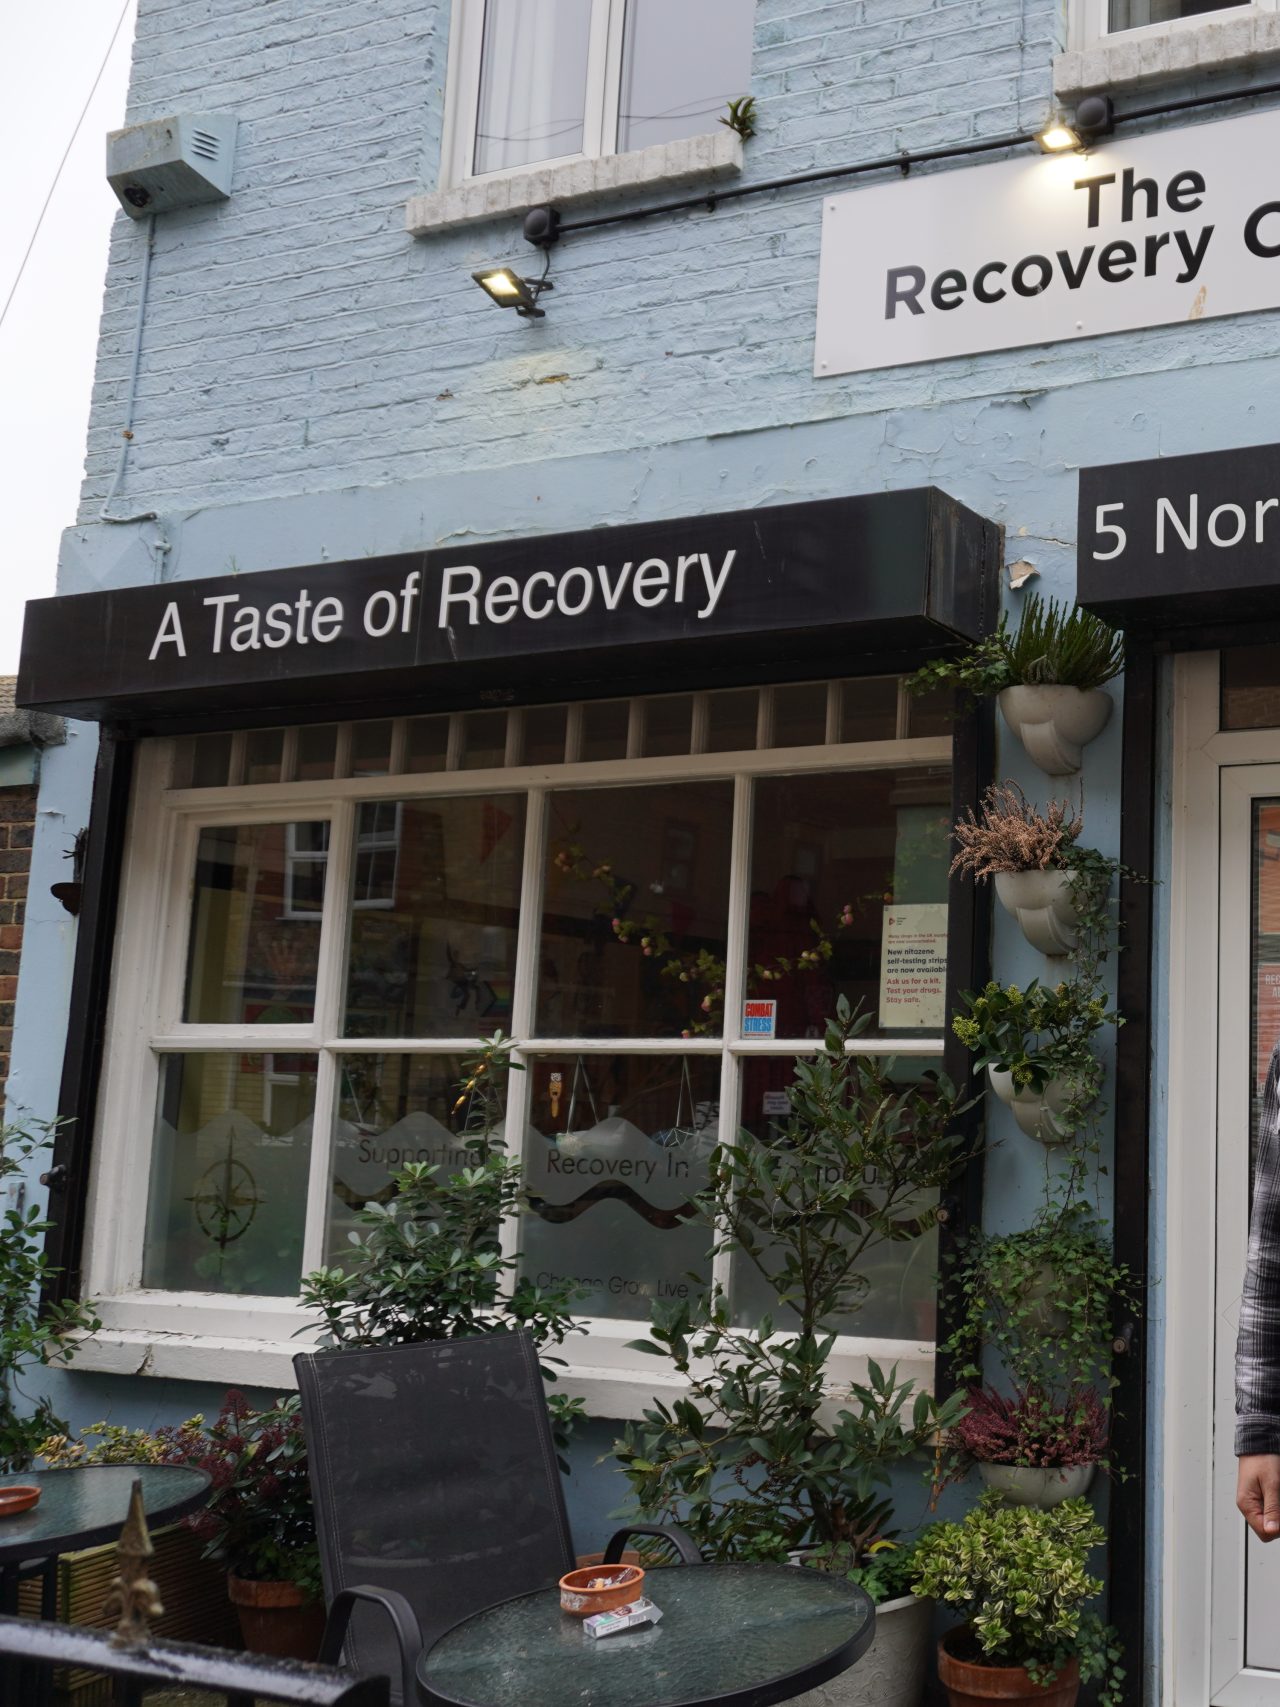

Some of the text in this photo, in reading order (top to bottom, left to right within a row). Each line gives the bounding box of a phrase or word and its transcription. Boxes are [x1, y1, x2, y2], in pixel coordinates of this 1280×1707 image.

[1075, 167, 1206, 229] The
[884, 224, 1216, 320] Recovery
[1092, 502, 1128, 561] 5
[148, 549, 738, 660] A Taste of Recovery
[744, 1017, 772, 1032] STRESS
[745, 1003, 774, 1017] COMBAT
[547, 1149, 659, 1183] Recovery
[667, 1151, 690, 1178] In
[657, 1279, 689, 1299] Live
